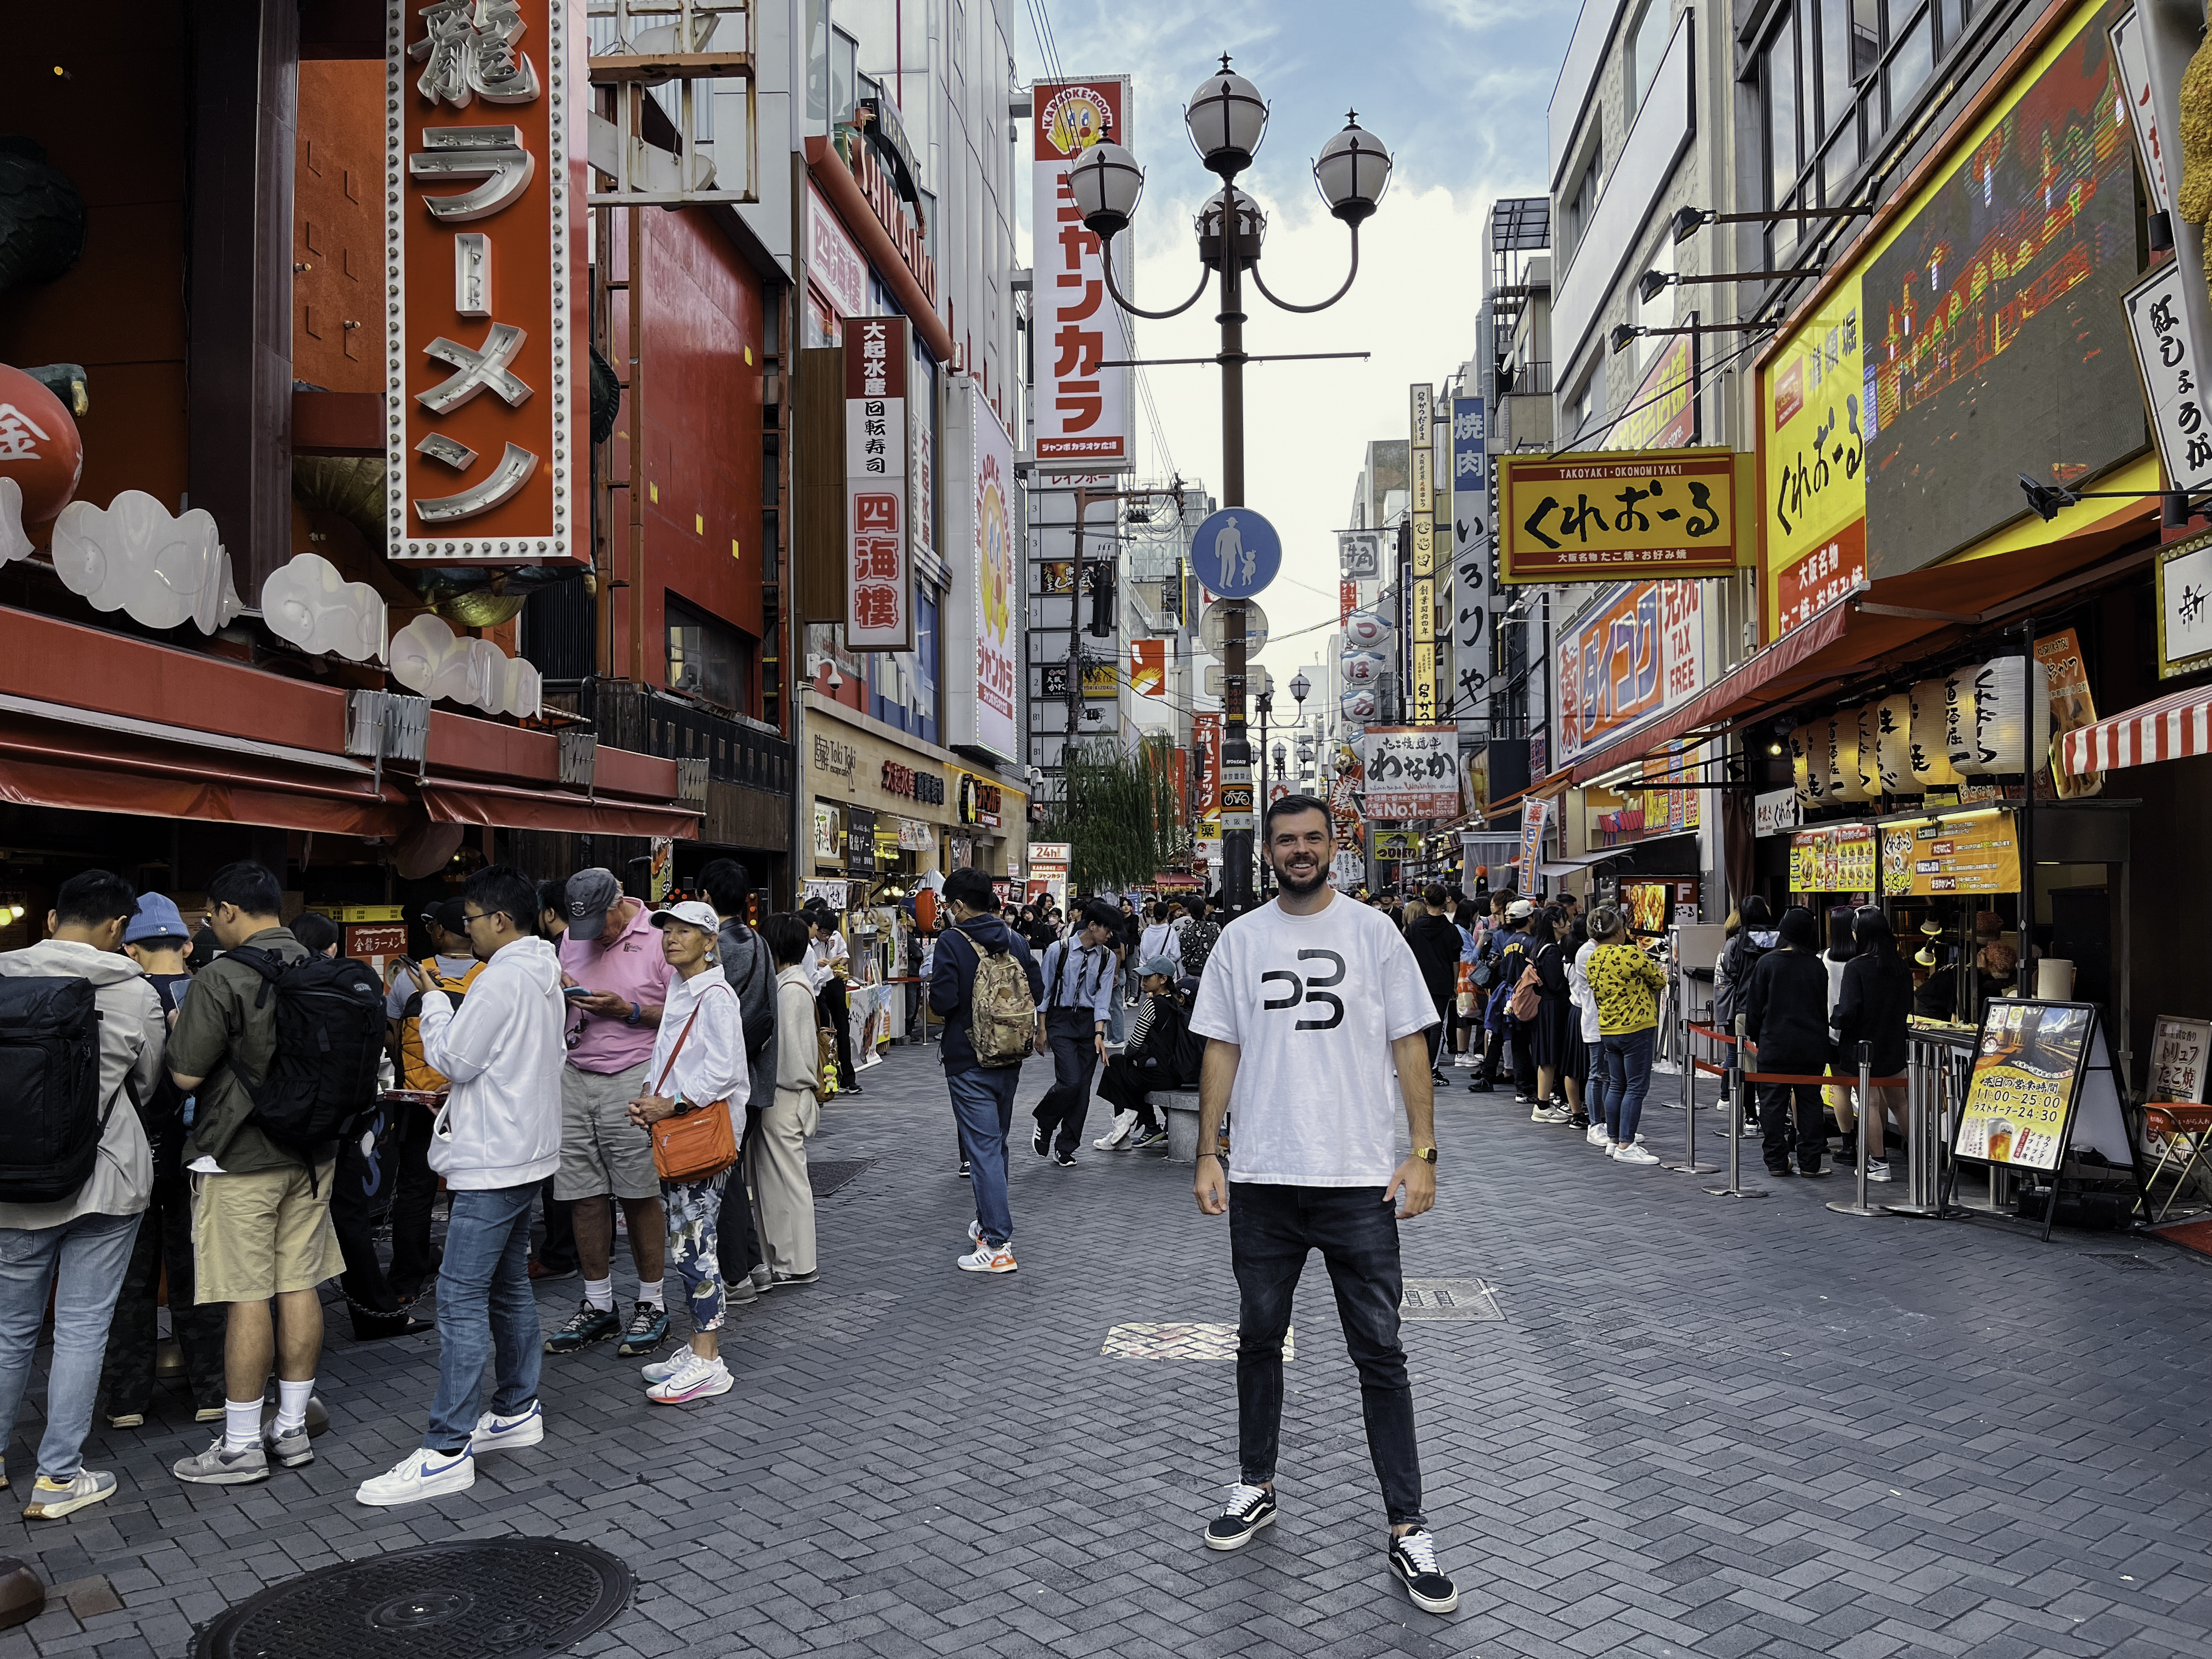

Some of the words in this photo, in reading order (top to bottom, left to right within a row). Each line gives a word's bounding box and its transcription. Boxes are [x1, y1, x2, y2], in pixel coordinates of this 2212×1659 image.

[883, 107, 918, 188] PACHINKO
[862, 321, 887, 397] 大起水産
[1809, 307, 1857, 392] 道頓堀
[864, 400, 886, 473] 回転寿司
[1042, 441, 1117, 452] ジャンボカラオケ広場
[1454, 412, 1485, 478] 焼肉
[1778, 393, 1863, 537] くれおーる
[1524, 479, 1719, 549] くれおーる
[854, 493, 900, 629] 四海樓
[1345, 544, 1374, 567] 牛角
[1558, 551, 1598, 563] 大阪名物
[1600, 549, 1688, 562] たこ焼・お好み焼
[1798, 541, 1838, 591] 大阪名物
[1418, 584, 1430, 636] 創業昭和四年
[1456, 516, 1485, 703] いろりや
[1582, 582, 1660, 735] ダイコク
[1672, 622, 1691, 662] TAX
[977, 637, 1013, 699] ジャンカラ
[1670, 657, 1695, 698] FREE
[2046, 656, 2078, 685] 串かつ
[1560, 644, 1579, 755] 薬
[830, 740, 843, 765] Toki
[1382, 736, 1442, 751] たこ焼道楽
[881, 759, 916, 797] 大起水産
[1367, 748, 1457, 782] わなか
[1384, 802, 1418, 817] No.1
[1528, 804, 1543, 823] 薬
[1201, 824, 1215, 837] 薬
[1036, 847, 1057, 858] 24h
[1894, 856, 1900, 868] の
[354, 936, 400, 953] 金龍ラーメン
[2162, 1040, 2200, 1066] トリュフ
[1983, 1075, 2059, 1095] 本日の営業時間
[2157, 1062, 2196, 1091] たこ焼
